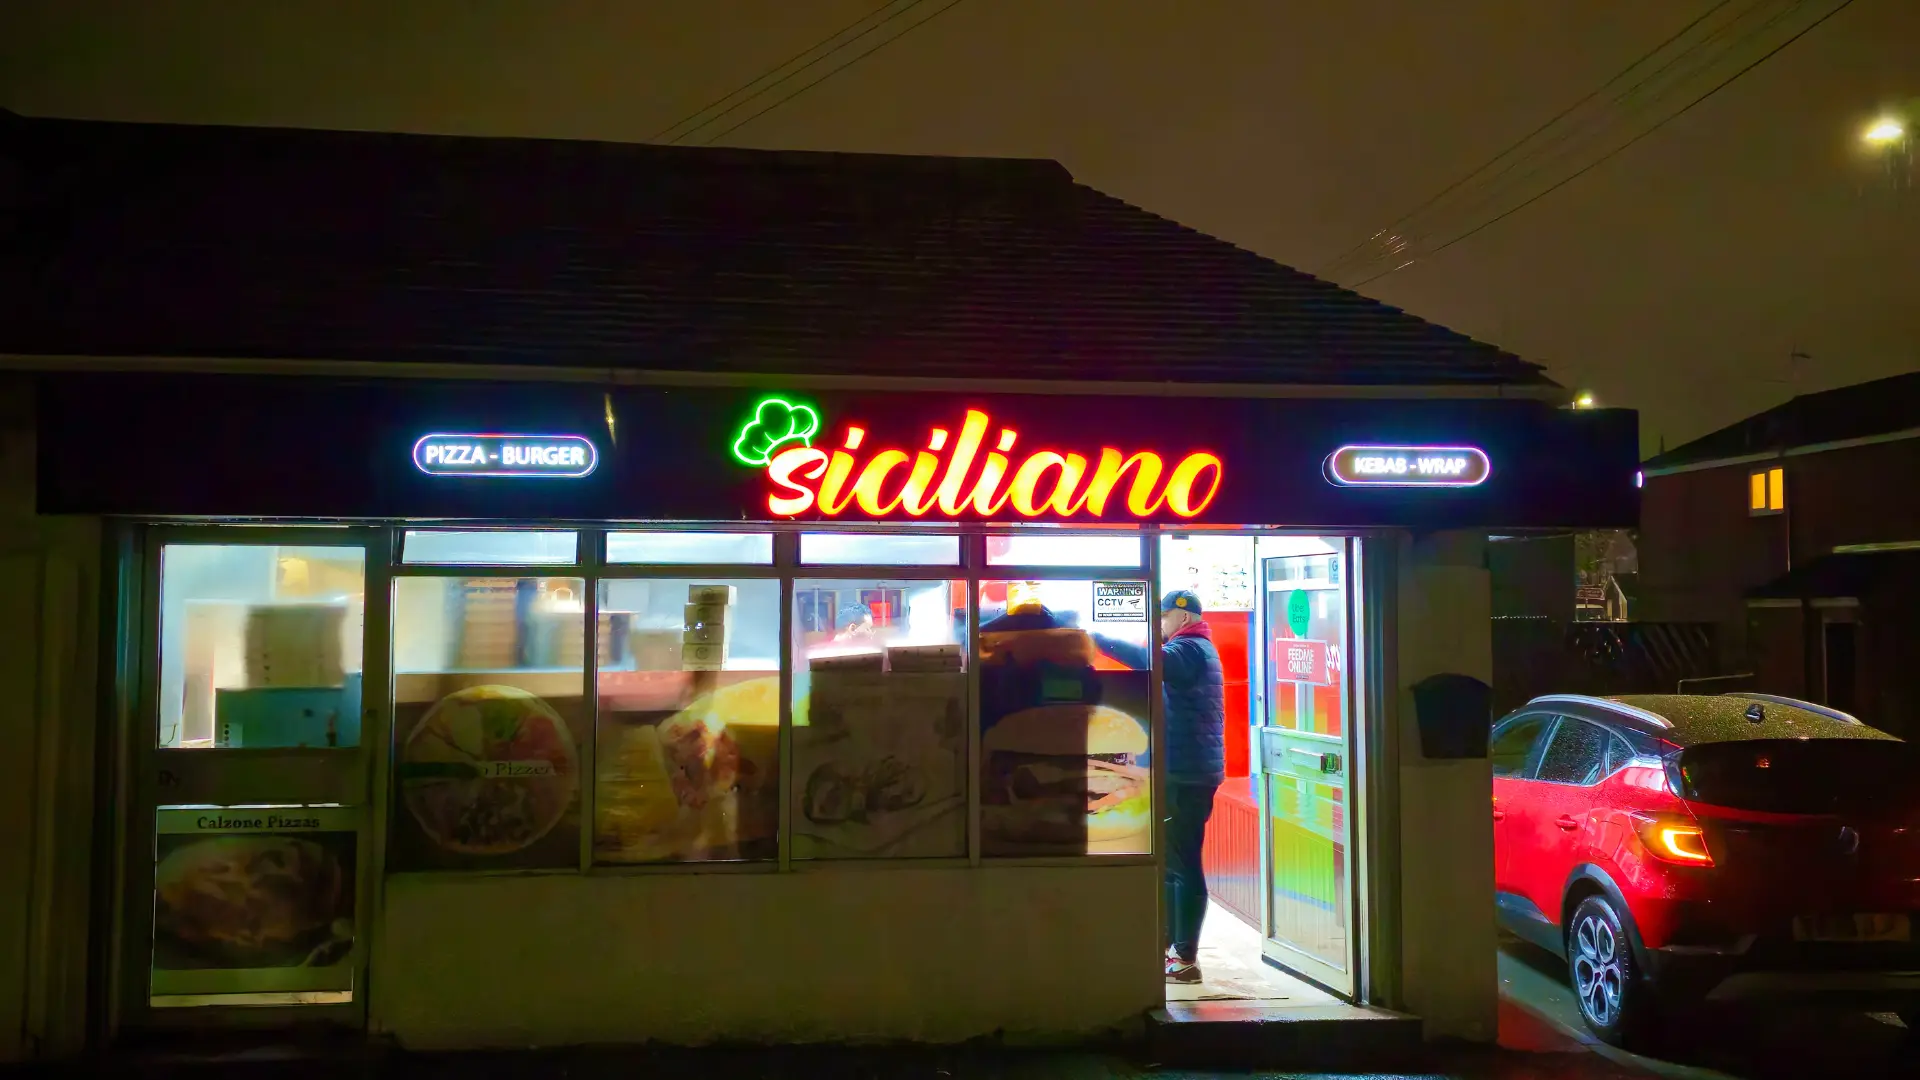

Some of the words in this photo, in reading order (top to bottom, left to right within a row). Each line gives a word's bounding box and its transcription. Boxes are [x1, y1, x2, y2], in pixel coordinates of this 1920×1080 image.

[426, 445, 487, 464] PIZZA
[502, 446, 585, 465] BURGER
[1354, 457, 1407, 473] KEBAB
[1418, 458, 1466, 474] WRAP
[1098, 587, 1143, 596] WARNING
[1097, 598, 1124, 606] CCTV
[1291, 603, 1305, 613] Uber
[1292, 613, 1306, 623] Eats
[1287, 660, 1313, 673] ONLINE
[196, 815, 263, 829] Calzone
[267, 815, 321, 829] Pizzas
